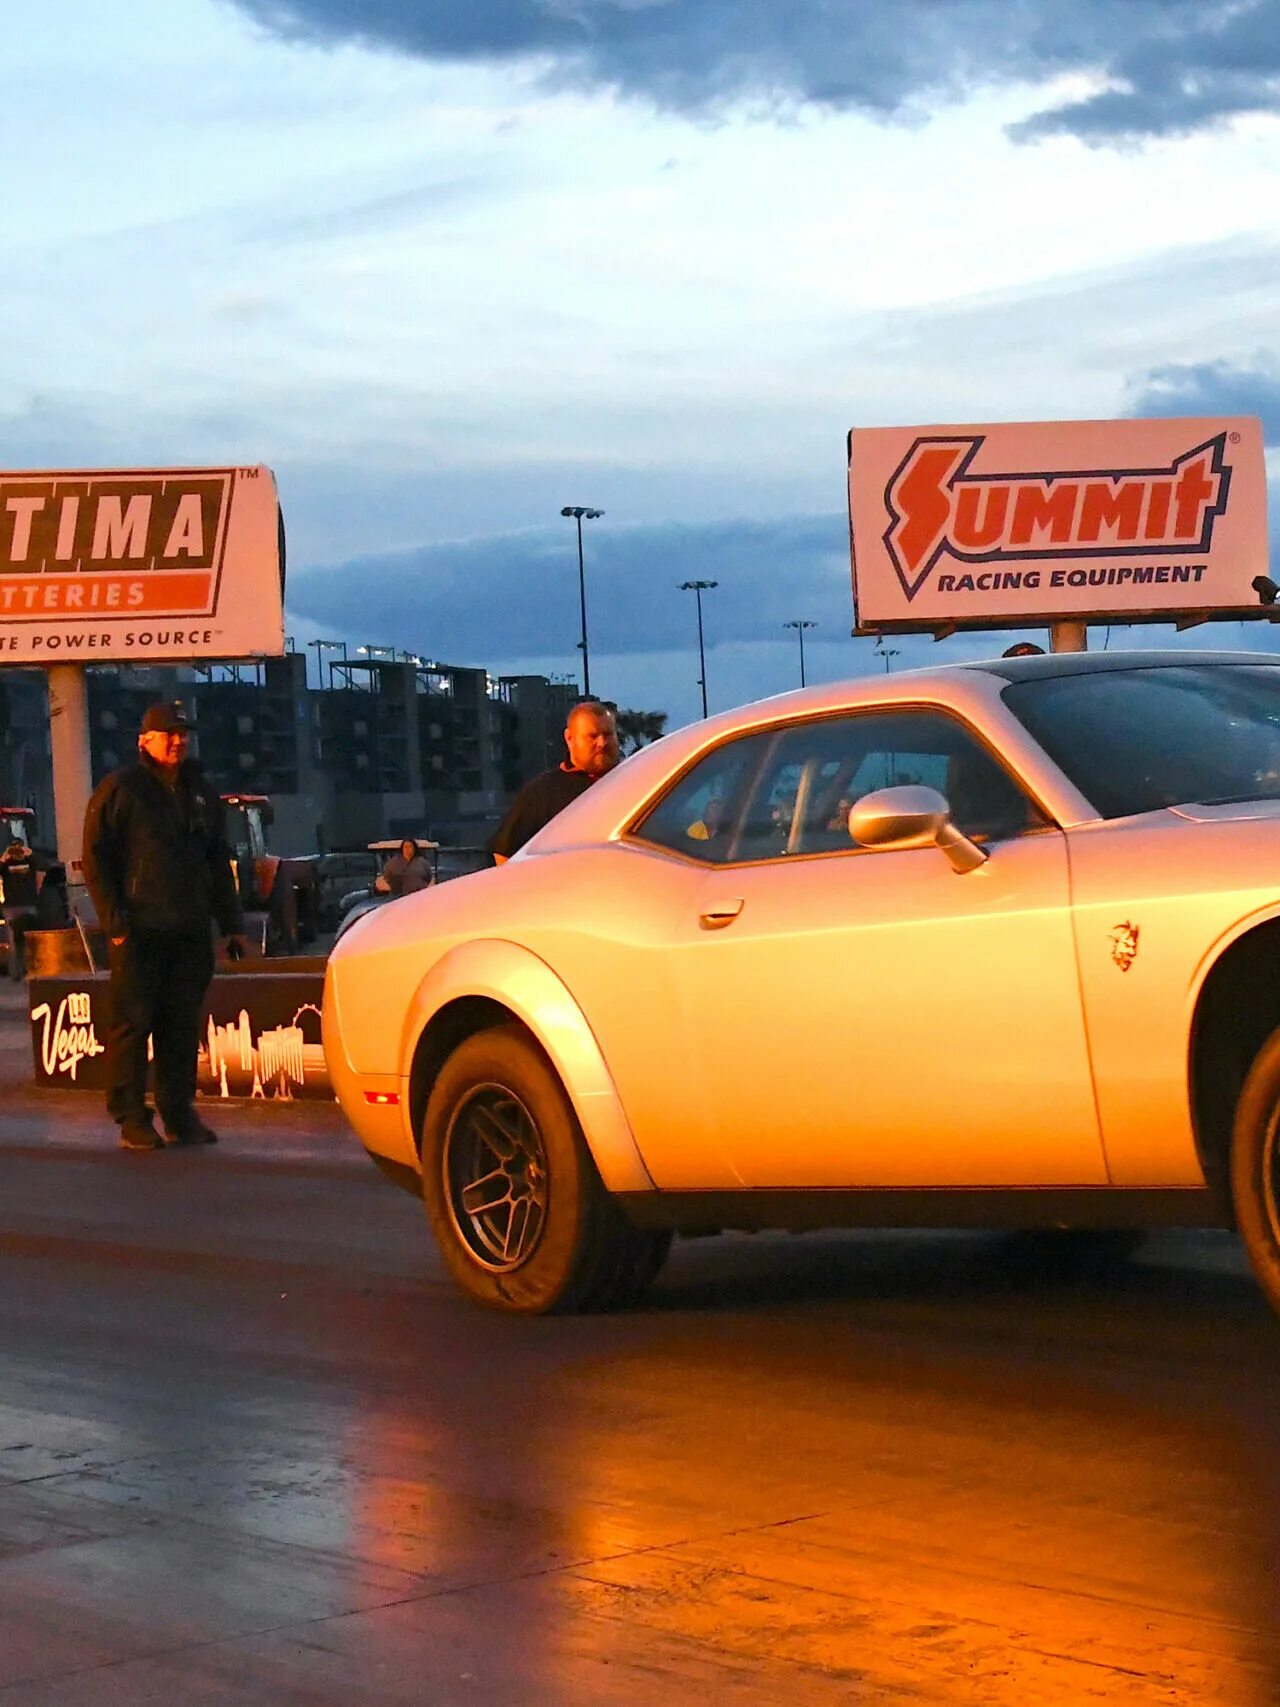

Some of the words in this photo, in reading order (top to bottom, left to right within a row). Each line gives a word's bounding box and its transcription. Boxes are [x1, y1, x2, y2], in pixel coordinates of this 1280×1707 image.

[6, 494, 204, 561] TIMA
[938, 571, 1041, 592] RACING
[1050, 565, 1208, 588] EQUIPMENT
[1, 583, 145, 608] TTERIES
[32, 634, 112, 649] POWER
[125, 631, 212, 646] SOURCE
[70, 996, 88, 1020] LAS
[31, 999, 105, 1081] Vegas
